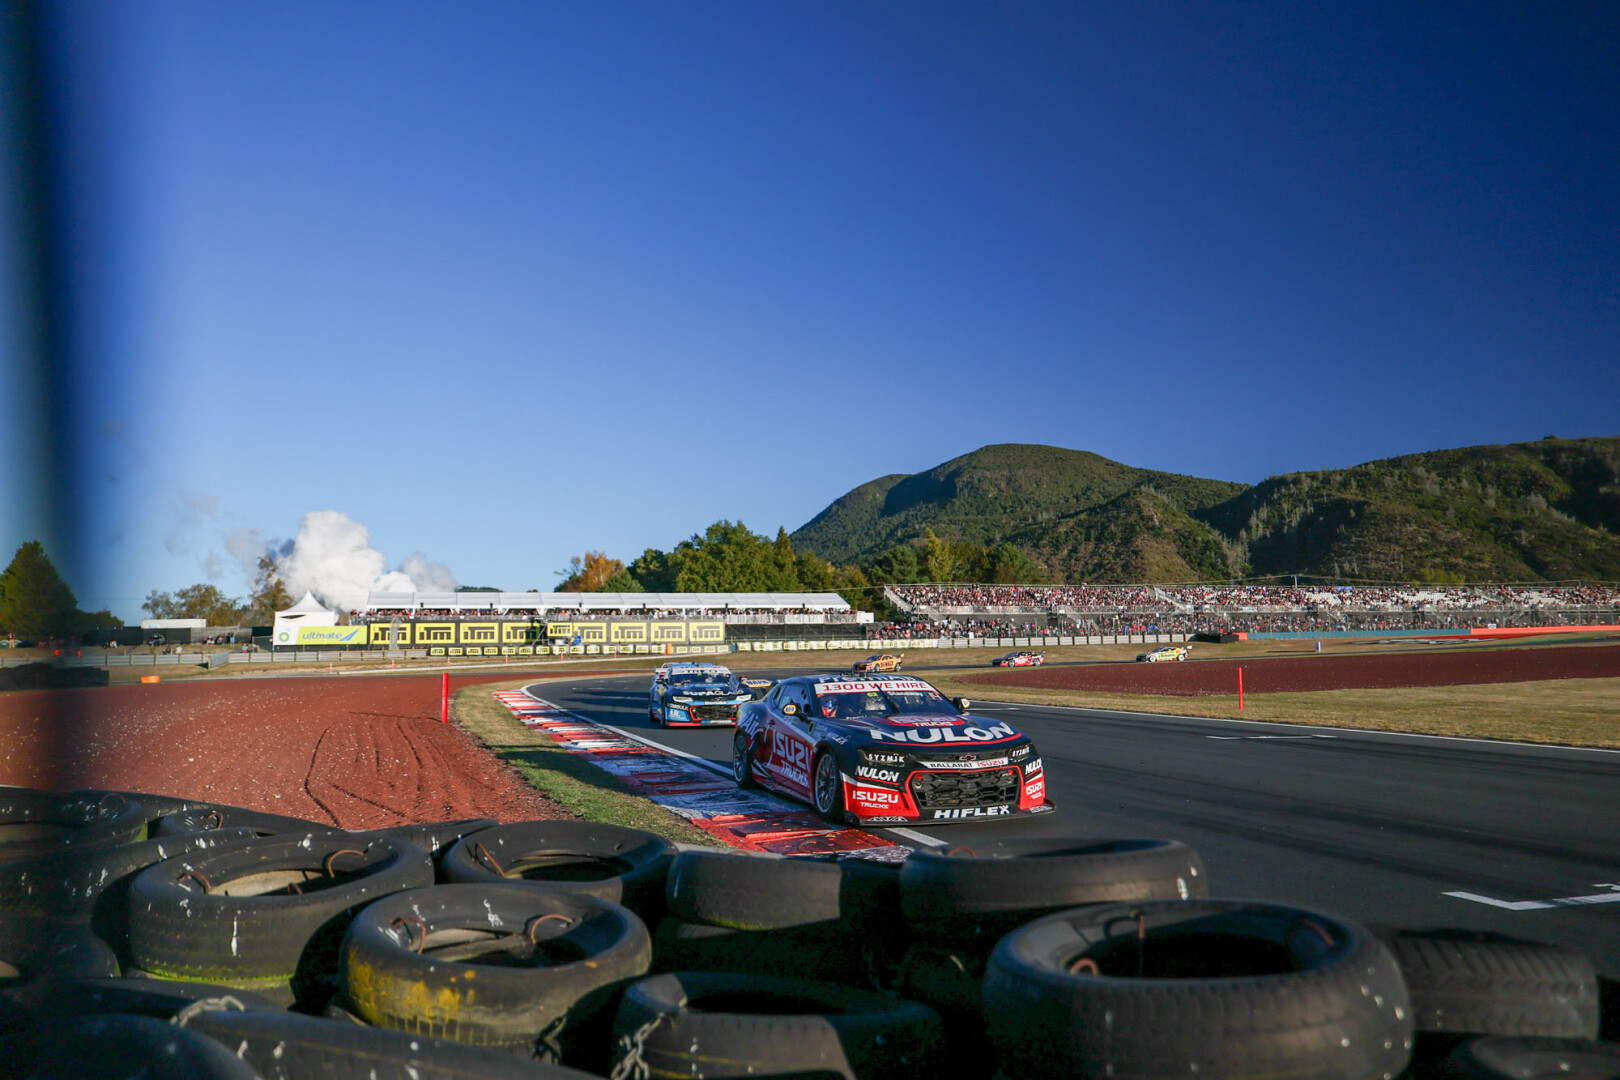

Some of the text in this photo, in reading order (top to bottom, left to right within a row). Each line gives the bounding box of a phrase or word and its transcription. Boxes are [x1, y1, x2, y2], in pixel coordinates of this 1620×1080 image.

[302, 631, 342, 639] ultimate
[823, 683, 865, 691] 1300
[870, 722, 1014, 743] NULON
[868, 753, 905, 763] SYZMIK
[855, 765, 899, 782] NULON
[852, 790, 899, 803] ISUZU
[860, 801, 889, 809] TRUCKS
[934, 805, 1010, 818] HIFLEX
